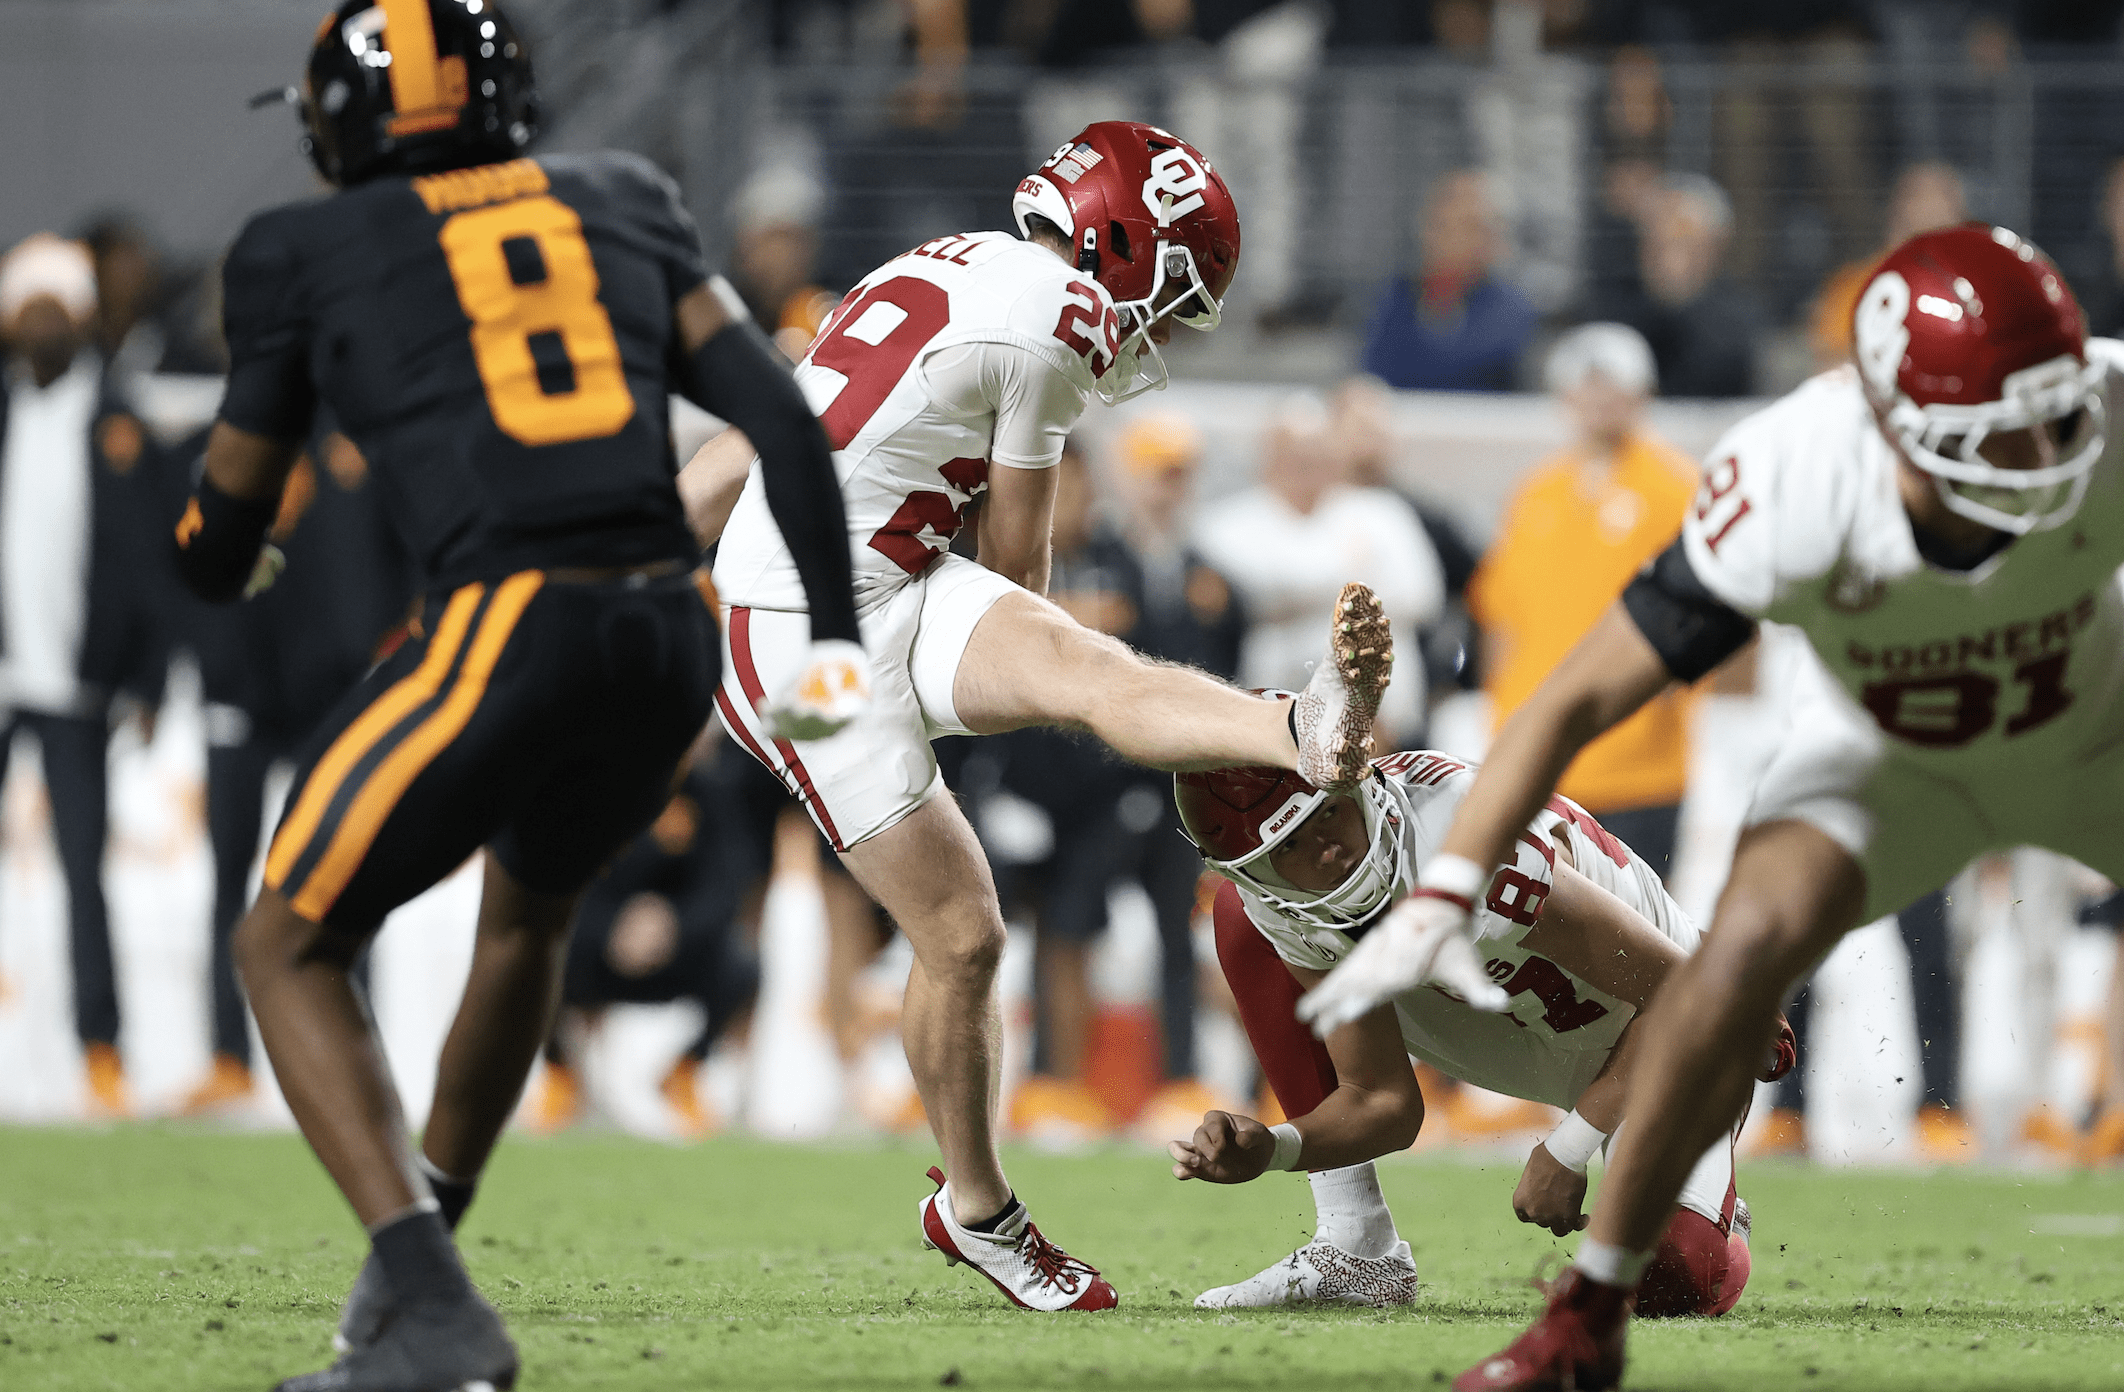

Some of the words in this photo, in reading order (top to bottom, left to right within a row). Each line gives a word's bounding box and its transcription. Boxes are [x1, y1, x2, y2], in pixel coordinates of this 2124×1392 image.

[1015, 178, 1043, 198] ERS
[1038, 143, 1075, 170] 9
[884, 233, 993, 265] ELL
[437, 193, 637, 446] 8
[1053, 280, 1120, 379] 29
[803, 275, 950, 450] 9
[1846, 592, 2096, 670] SOONERS
[1862, 654, 2076, 748] 81
[1268, 804, 1302, 835] OKLAHOMA
[1496, 955, 1609, 1033] 7
